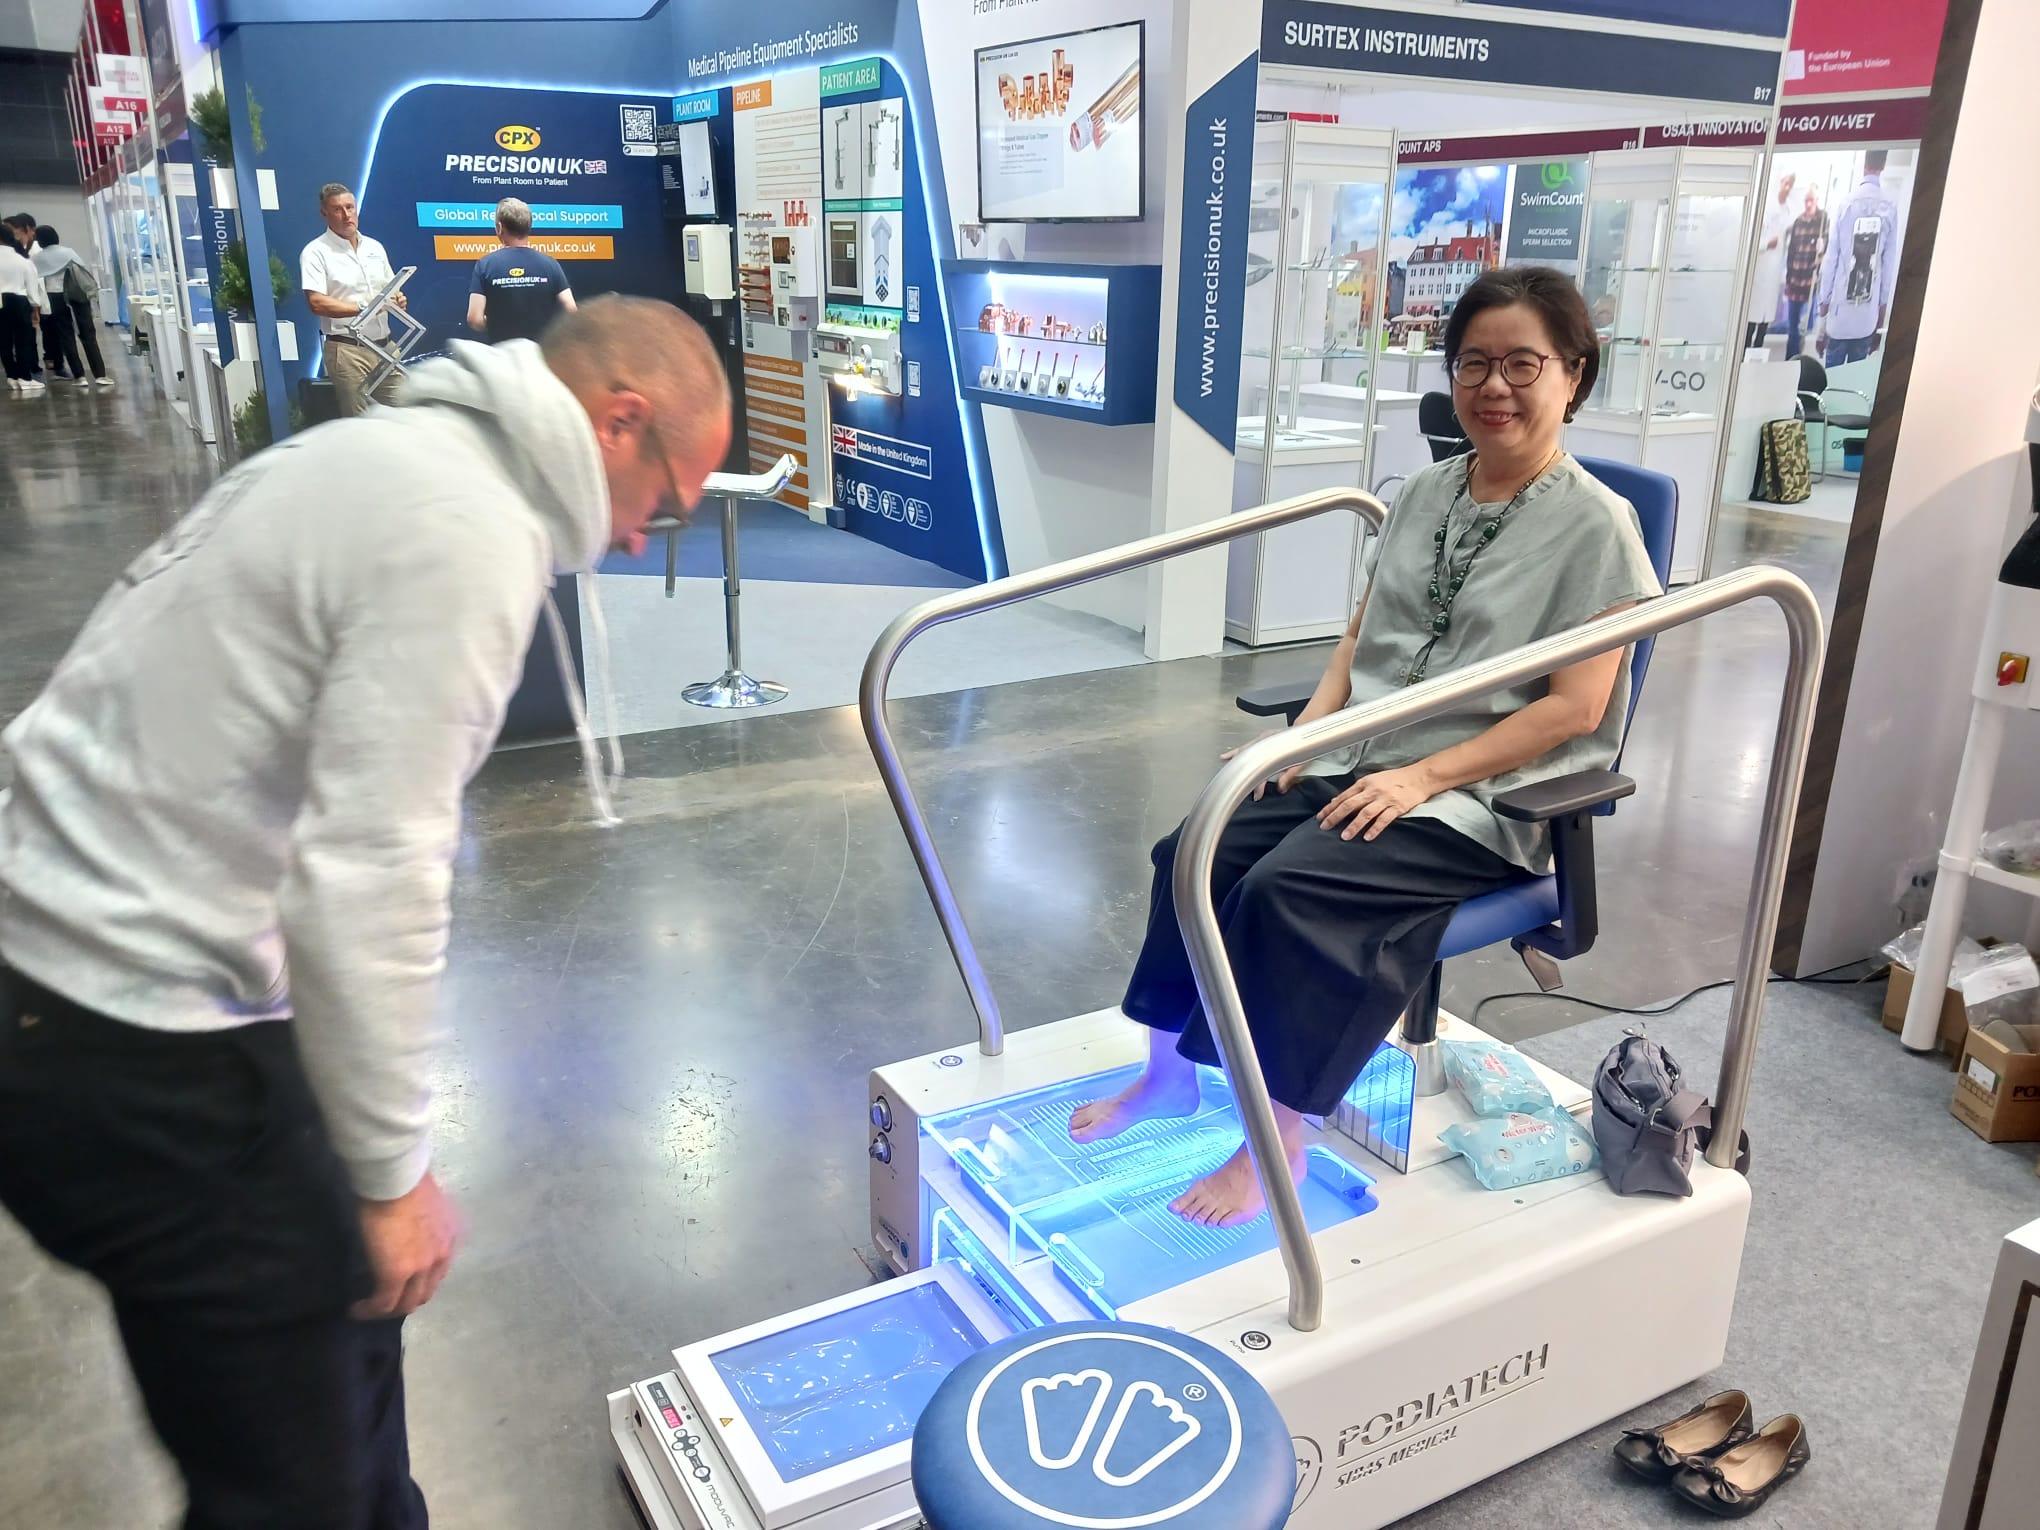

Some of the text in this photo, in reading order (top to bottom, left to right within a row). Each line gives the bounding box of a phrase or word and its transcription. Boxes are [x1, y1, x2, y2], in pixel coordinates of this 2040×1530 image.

[1284, 20, 1489, 62] SURTEX INSTRUMENTS
[688, 21, 858, 78] Medical Pipeline Equipment Specialists
[1808, 50, 1851, 61] Funded by
[1808, 58, 1891, 73] the European Union
[822, 66, 877, 91] PATIENT AREA
[736, 88, 761, 105] PIPELINE
[1754, 86, 1771, 101] B17
[115, 100, 137, 111] A16
[676, 98, 711, 117] PLANT ROOM
[1662, 123, 1695, 138] OSAA
[1782, 115, 1820, 132] IV-GO
[1829, 112, 1876, 130] IV-VET
[499, 131, 534, 145] CPX
[1399, 140, 1441, 155] OUNT APS
[472, 176, 568, 186] From Plant Room to Patient
[1520, 191, 1584, 206] SwimCount
[434, 208, 478, 222] Global
[531, 209, 558, 222] ocal
[560, 209, 609, 224] Support
[1541, 238, 1573, 247] SELECTION
[1200, 117, 1228, 398] www.precisionuk.co.uk
[858, 440, 872, 453] Made
[877, 445, 887, 457] the
[886, 447, 903, 461] United
[903, 452, 928, 468] Kingdom
[1336, 1342, 1549, 1458] PODIATECH
[1333, 1425, 1457, 1490] SIDAS MEDICAL
